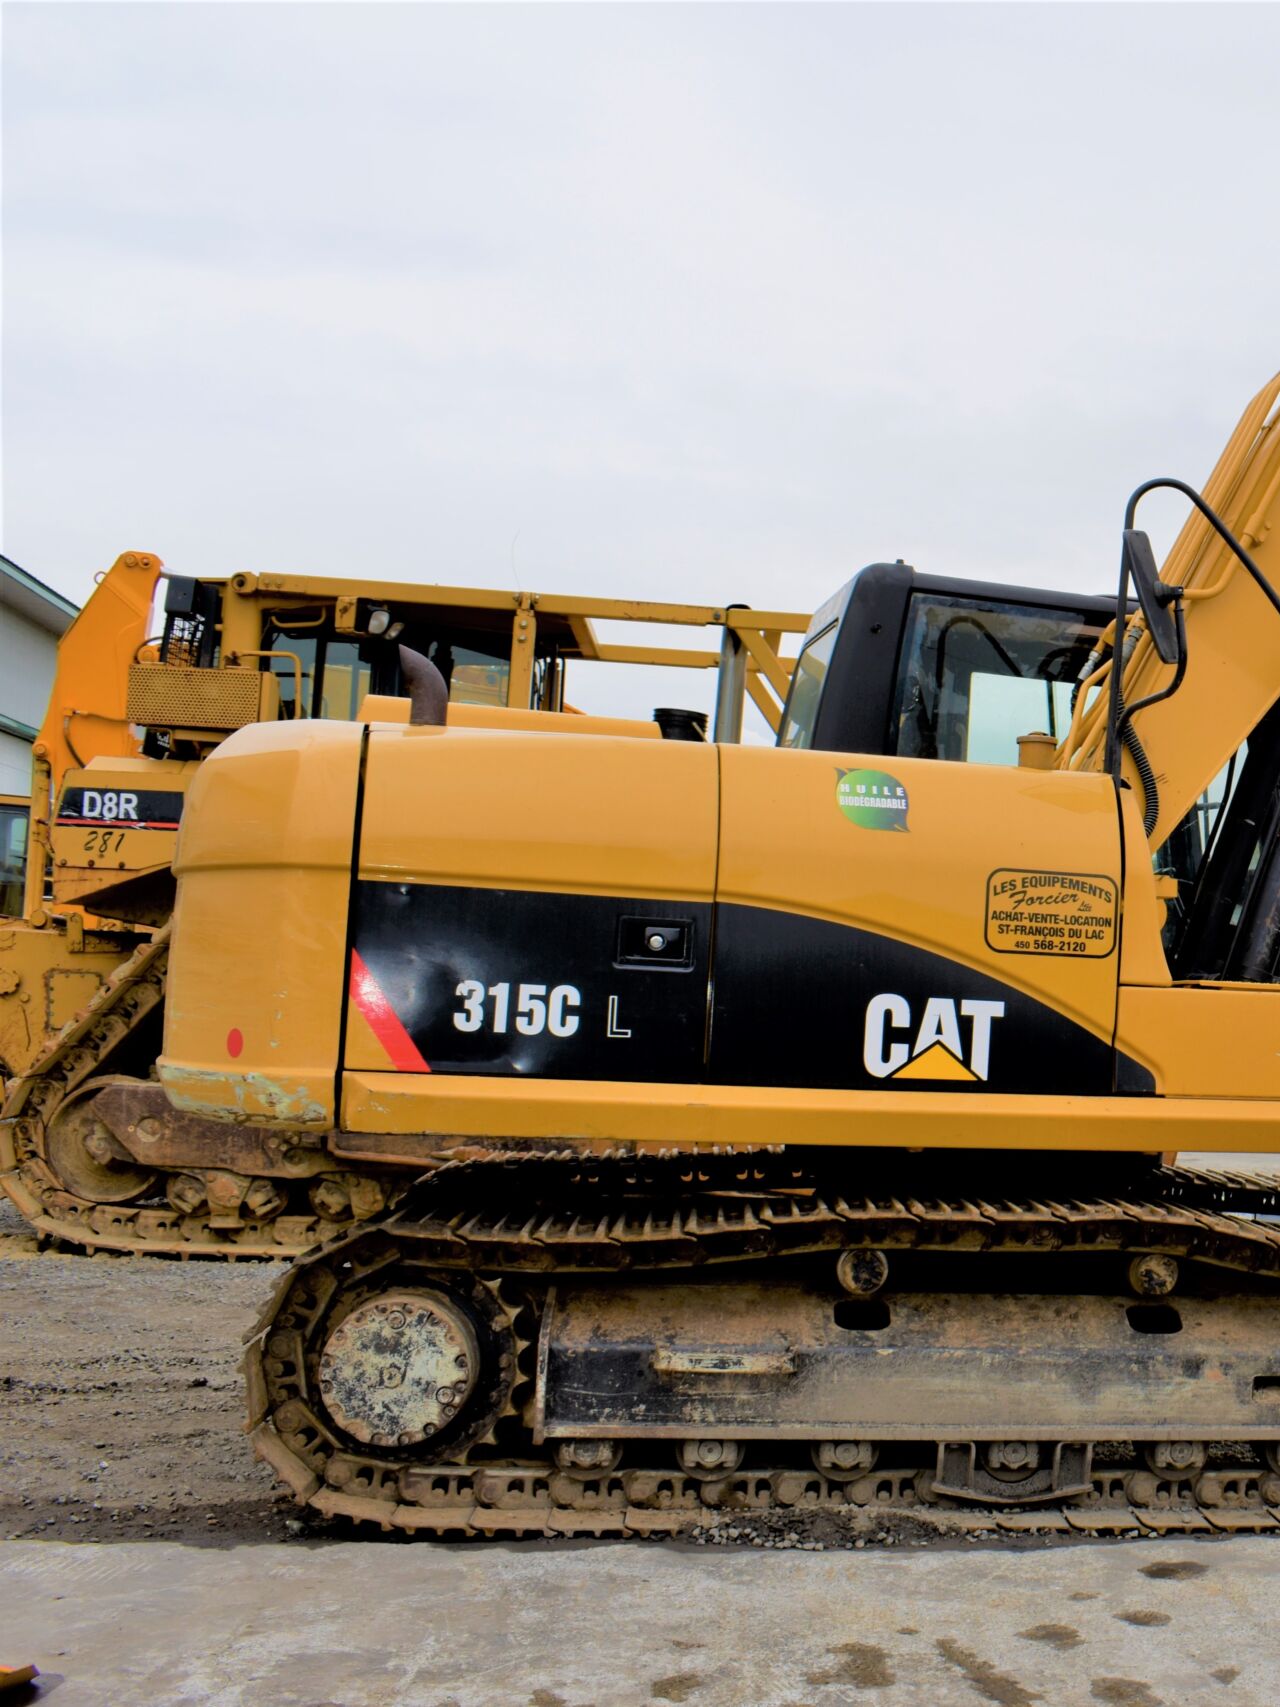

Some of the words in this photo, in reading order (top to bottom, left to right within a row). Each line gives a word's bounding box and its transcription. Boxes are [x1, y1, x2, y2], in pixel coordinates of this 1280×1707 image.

[840, 783, 905, 796] HUILE
[82, 790, 139, 820] D8R
[83, 830, 126, 853] 281
[992, 879, 1017, 896] LES
[1021, 875, 1113, 904] EQUIPEMENTS
[1008, 889, 1080, 911] Forcier
[991, 910, 1113, 928] ACHAT-VENTE-LOCATION
[997, 923, 1066, 940] ST-FRANÇOIS
[1068, 928, 1083, 939] DU
[1085, 929, 1105, 941] LAC
[1014, 940, 1031, 950] 450
[1033, 939, 1087, 953] 568-2120
[453, 979, 582, 1038] 315C
[606, 994, 632, 1039] L
[863, 992, 1006, 1082] CAT
